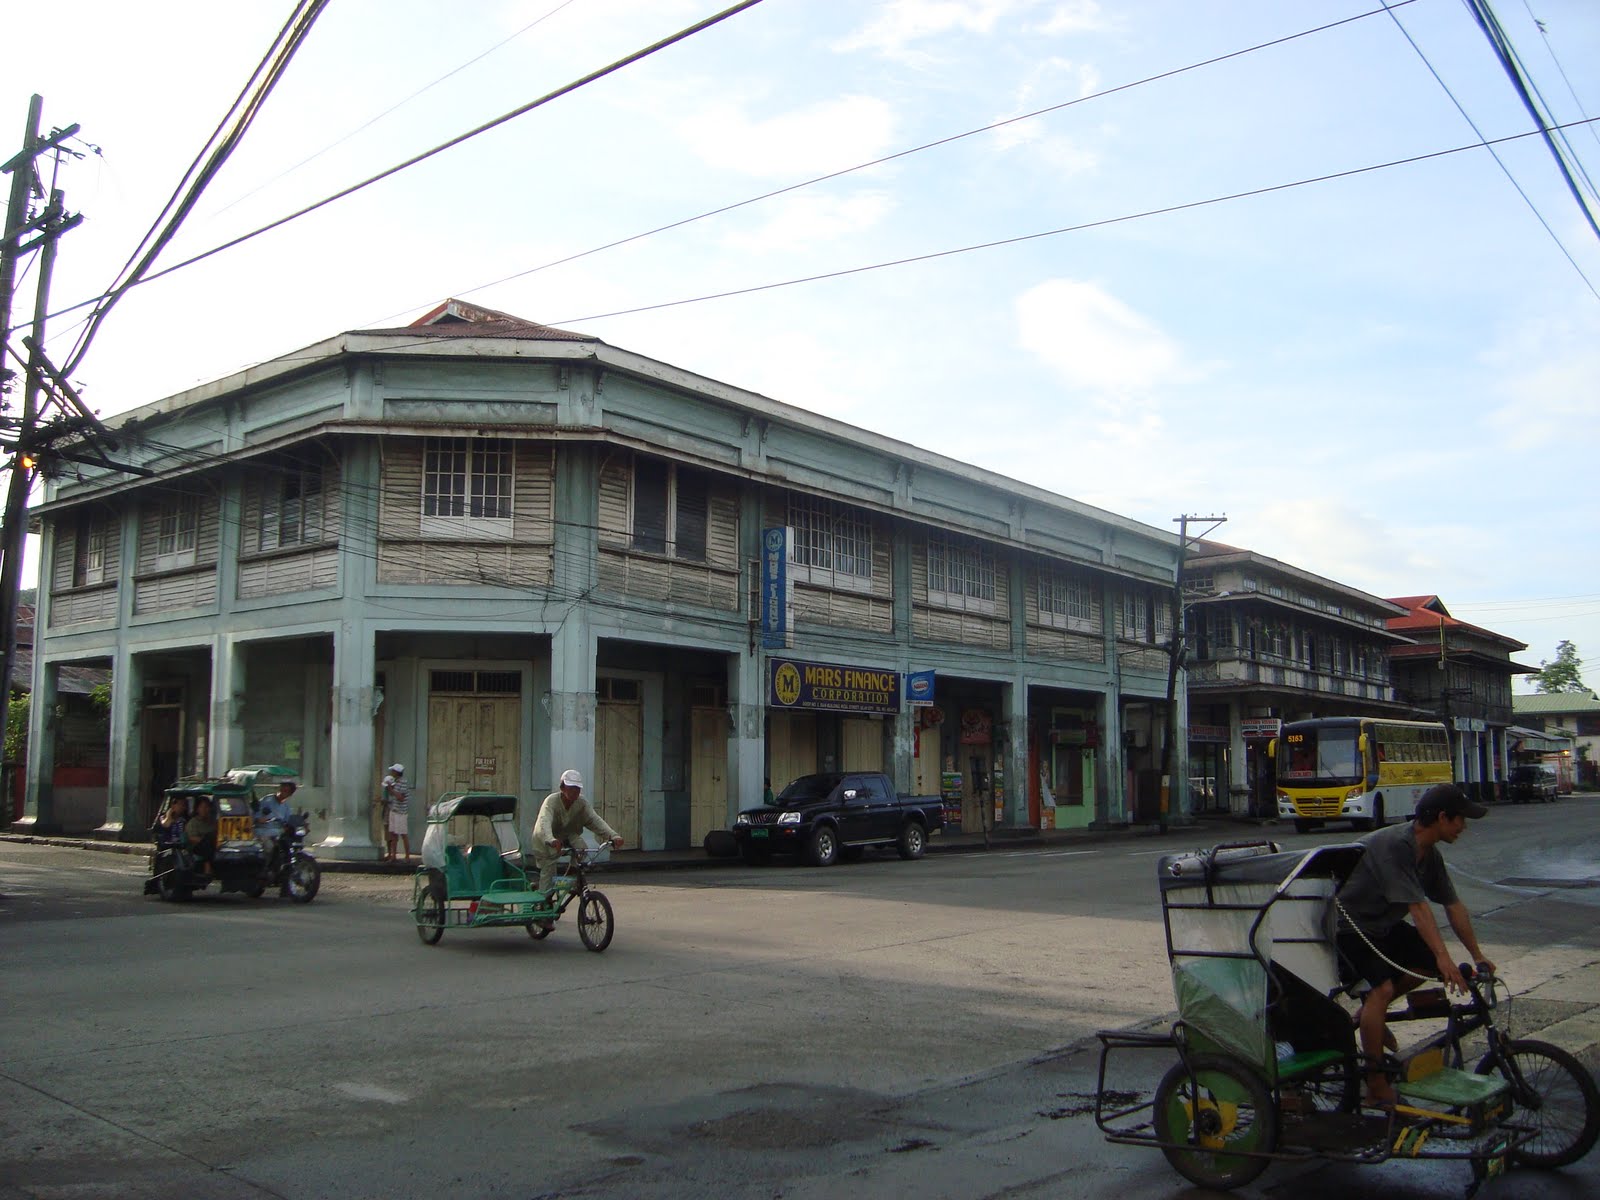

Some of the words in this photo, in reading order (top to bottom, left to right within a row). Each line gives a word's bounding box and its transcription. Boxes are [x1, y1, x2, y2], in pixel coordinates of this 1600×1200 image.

[783, 674, 795, 693] M
[805, 666, 841, 687] MARS
[845, 670, 895, 692] FINANCE
[812, 687, 889, 705] CORPORATION
[1287, 735, 1304, 743] 5163
